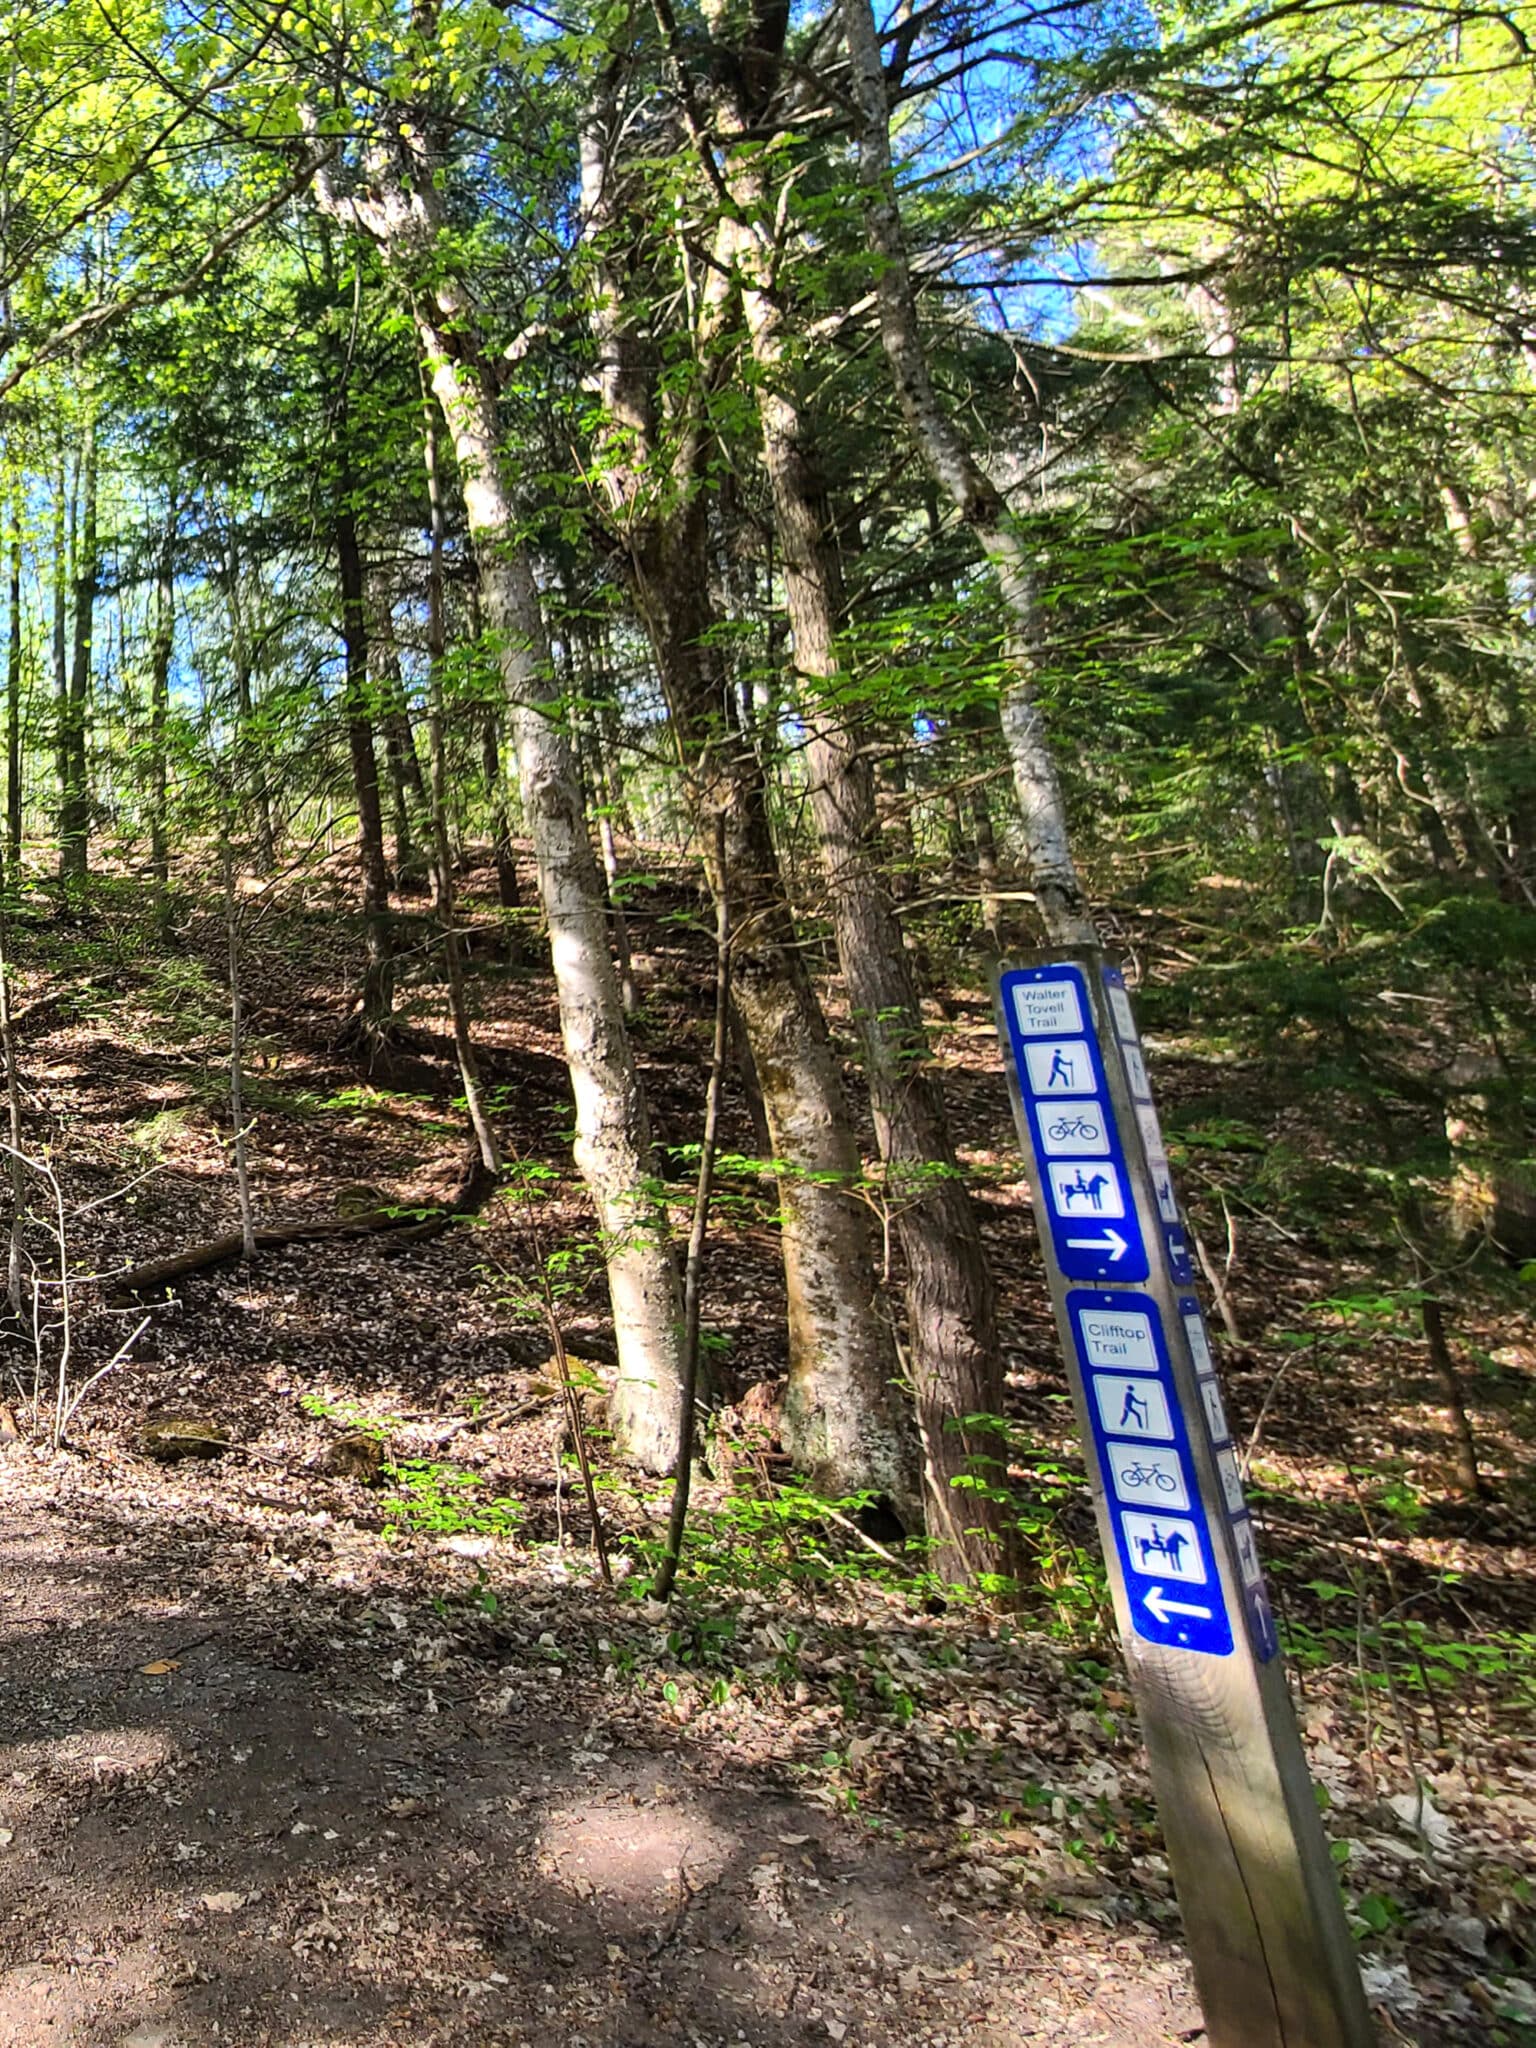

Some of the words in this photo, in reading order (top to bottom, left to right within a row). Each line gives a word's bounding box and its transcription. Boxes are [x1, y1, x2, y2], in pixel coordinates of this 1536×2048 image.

[1022, 989, 1066, 1000] Walter
[1025, 1003, 1064, 1014] Tovell
[1028, 1017, 1057, 1027] Trail
[1088, 1324, 1146, 1340] Clifftop
[1092, 1340, 1127, 1354] Trail
